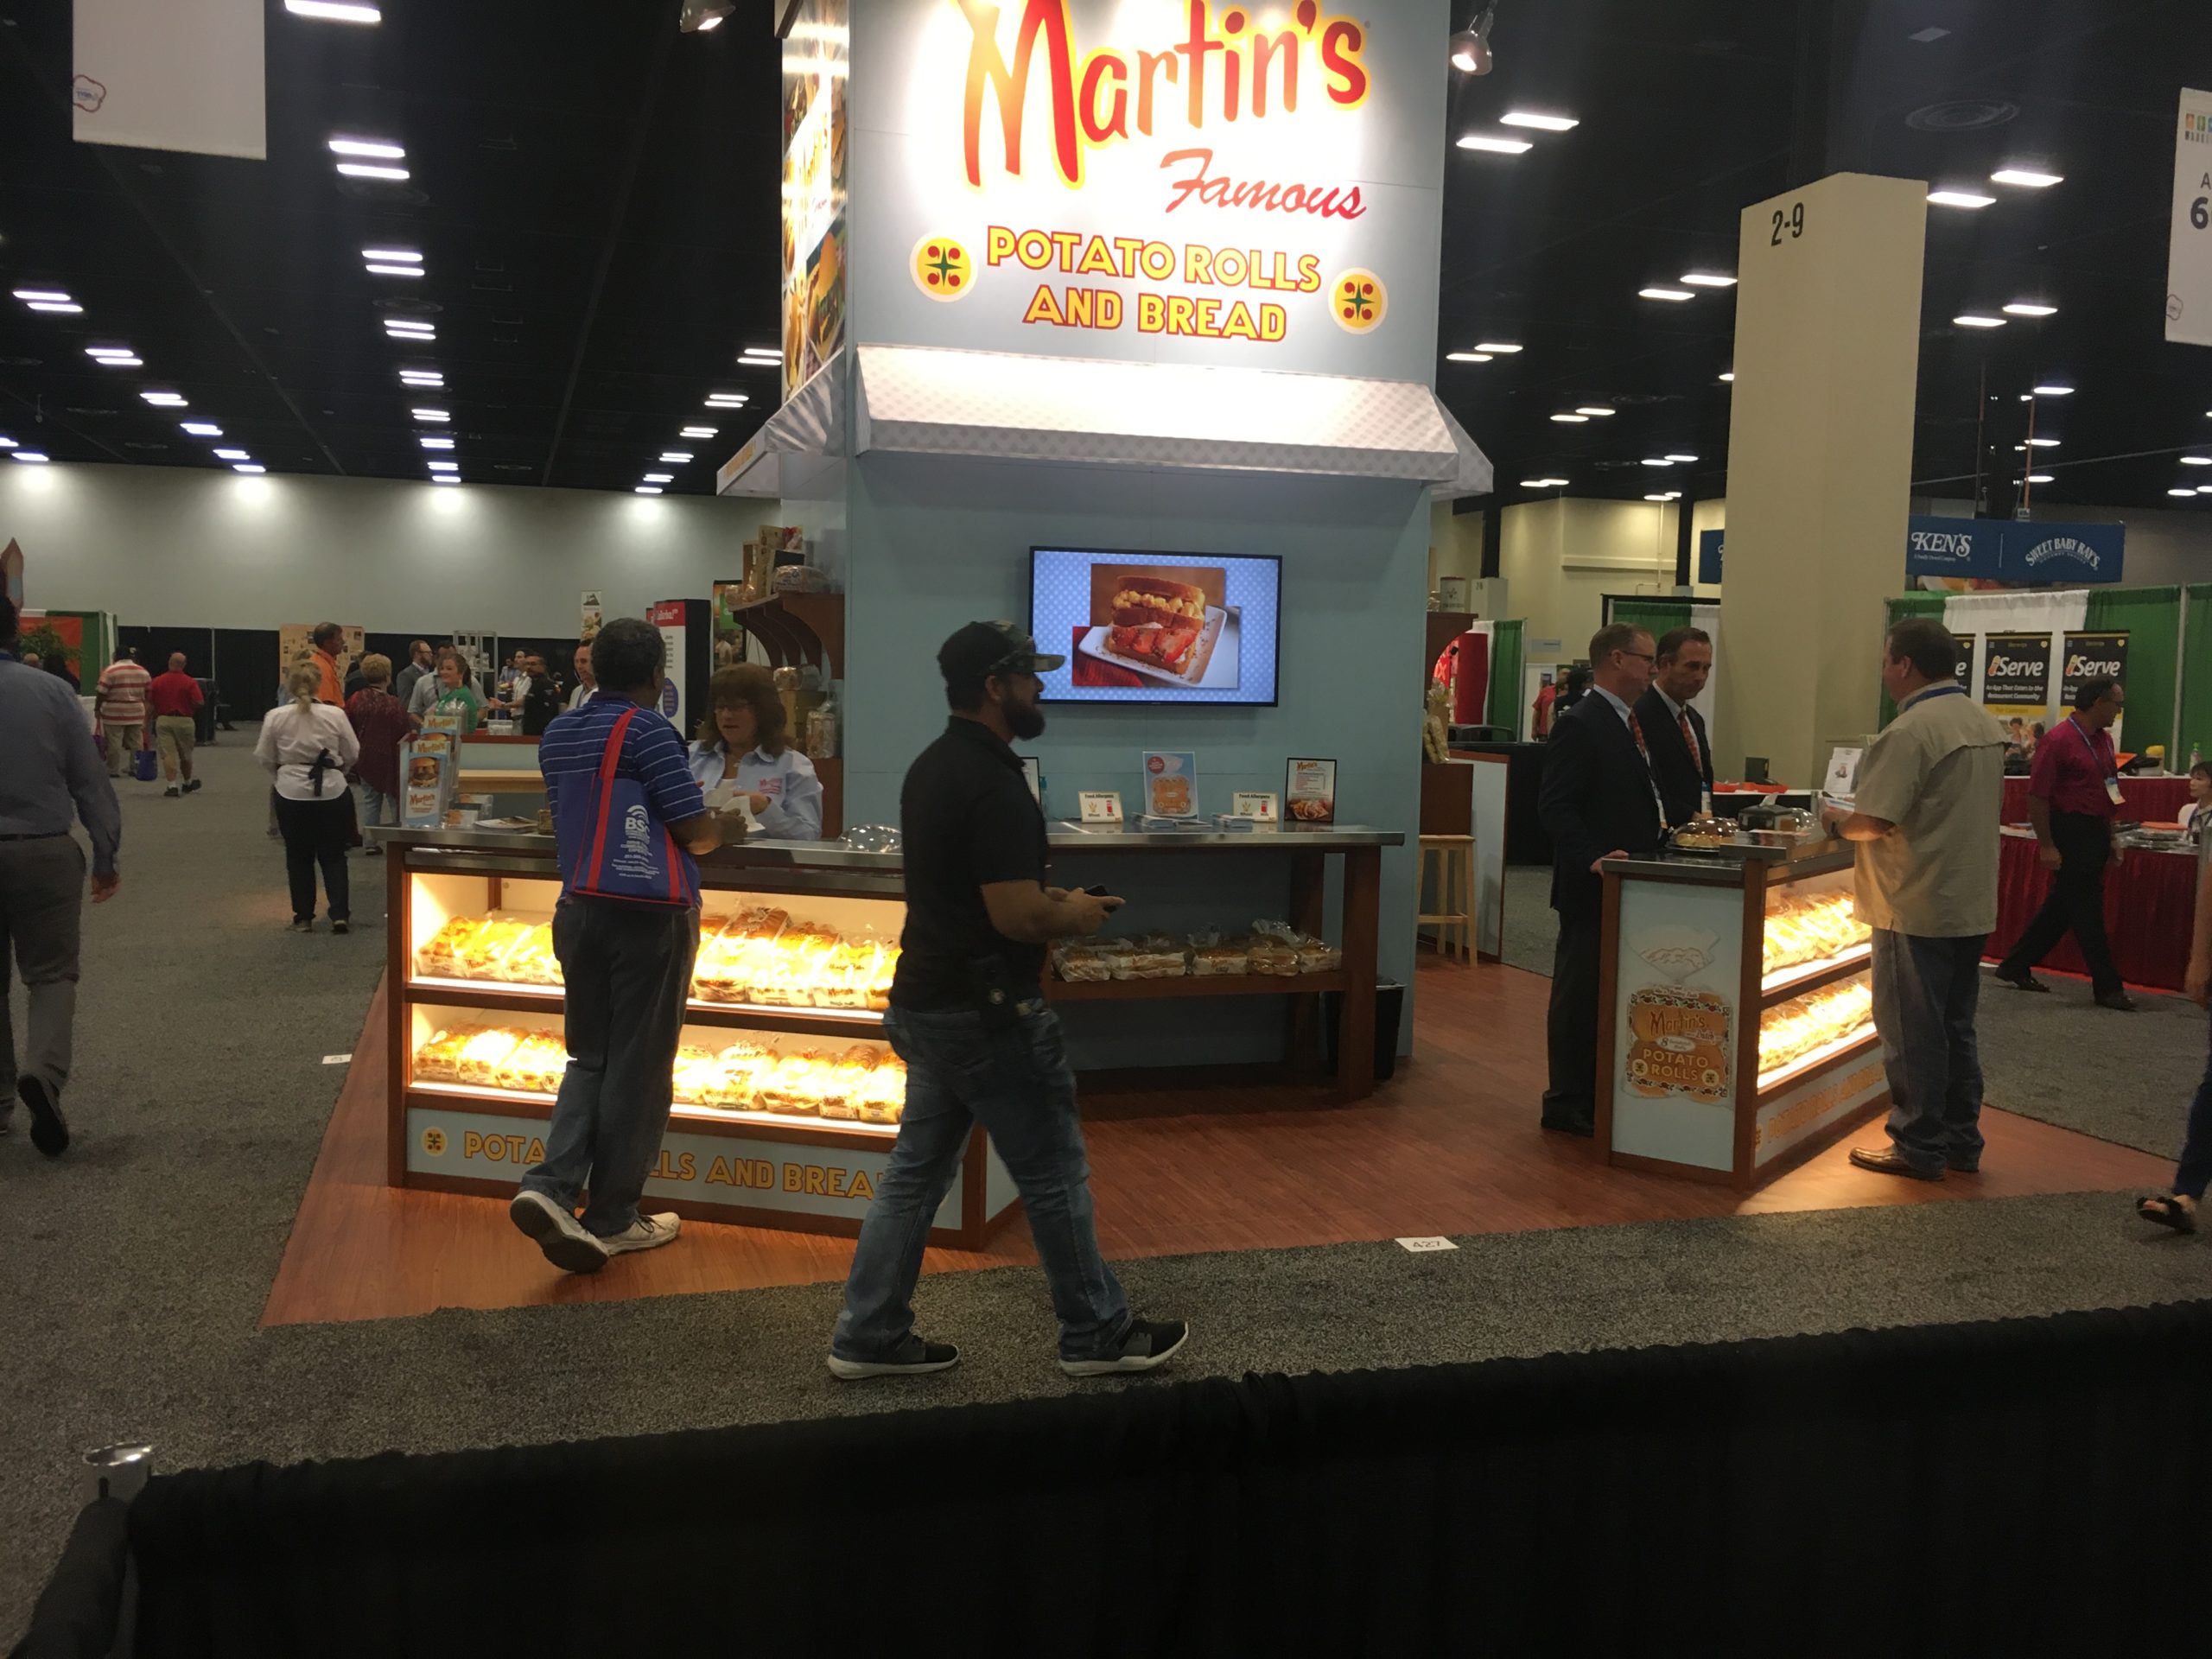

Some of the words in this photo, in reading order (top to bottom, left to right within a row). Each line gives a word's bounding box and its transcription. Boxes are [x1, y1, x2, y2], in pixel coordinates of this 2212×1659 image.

[959, 0, 1368, 188] Martin's
[1160, 148, 1367, 219] Famous
[1770, 201, 1804, 246] 2-9
[988, 225, 1176, 282] POTATO
[1185, 245, 1321, 293] ROLLS
[1022, 284, 1123, 330] AND
[1138, 294, 1287, 342] BREAD
[1911, 531, 1973, 557] KEN'S
[2025, 539, 2053, 567] SWEET
[2054, 537, 2078, 550] BABY
[2077, 542, 2101, 567] RAY'S
[1650, 1008, 1706, 1035] Martin's
[1643, 1048, 1708, 1068] POTATO
[1651, 1064, 1698, 1080] ROLLS
[464, 1131, 546, 1164] POTA
[705, 1155, 775, 1189] AND
[782, 1162, 884, 1200] BREA
